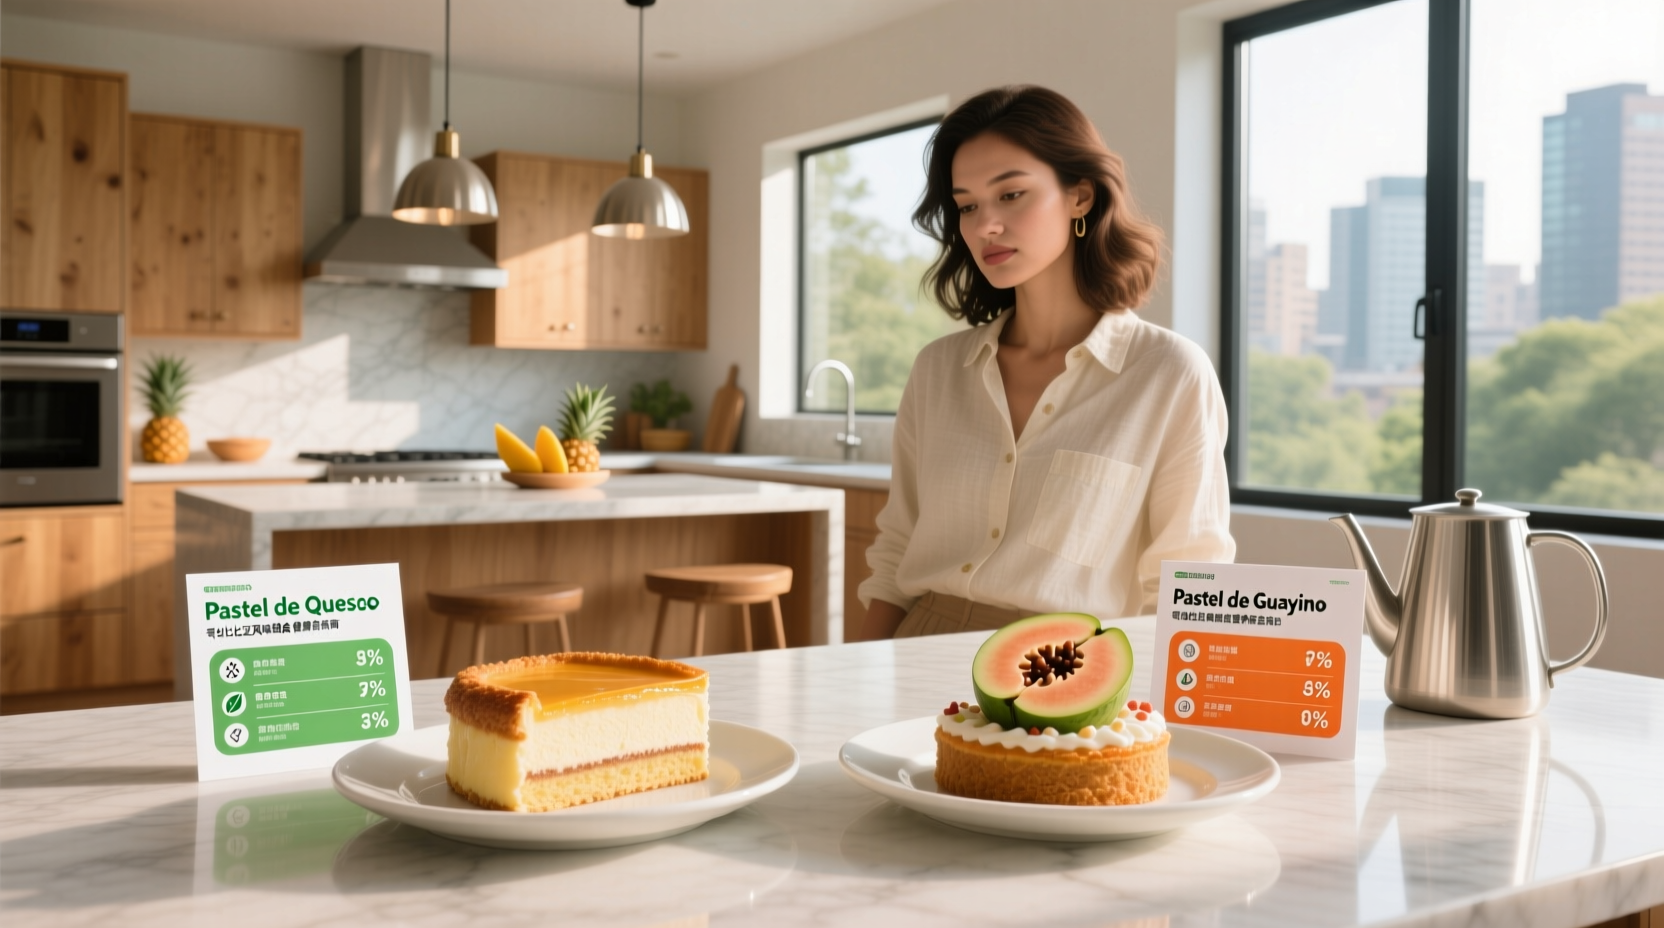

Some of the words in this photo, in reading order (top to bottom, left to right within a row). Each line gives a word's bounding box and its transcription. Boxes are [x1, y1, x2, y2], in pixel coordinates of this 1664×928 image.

[205, 597, 269, 621] Pastel
[274, 596, 300, 616] de
[1173, 588, 1224, 607] Pastel
[1227, 590, 1250, 608] de
[1253, 592, 1327, 616] Guayino
